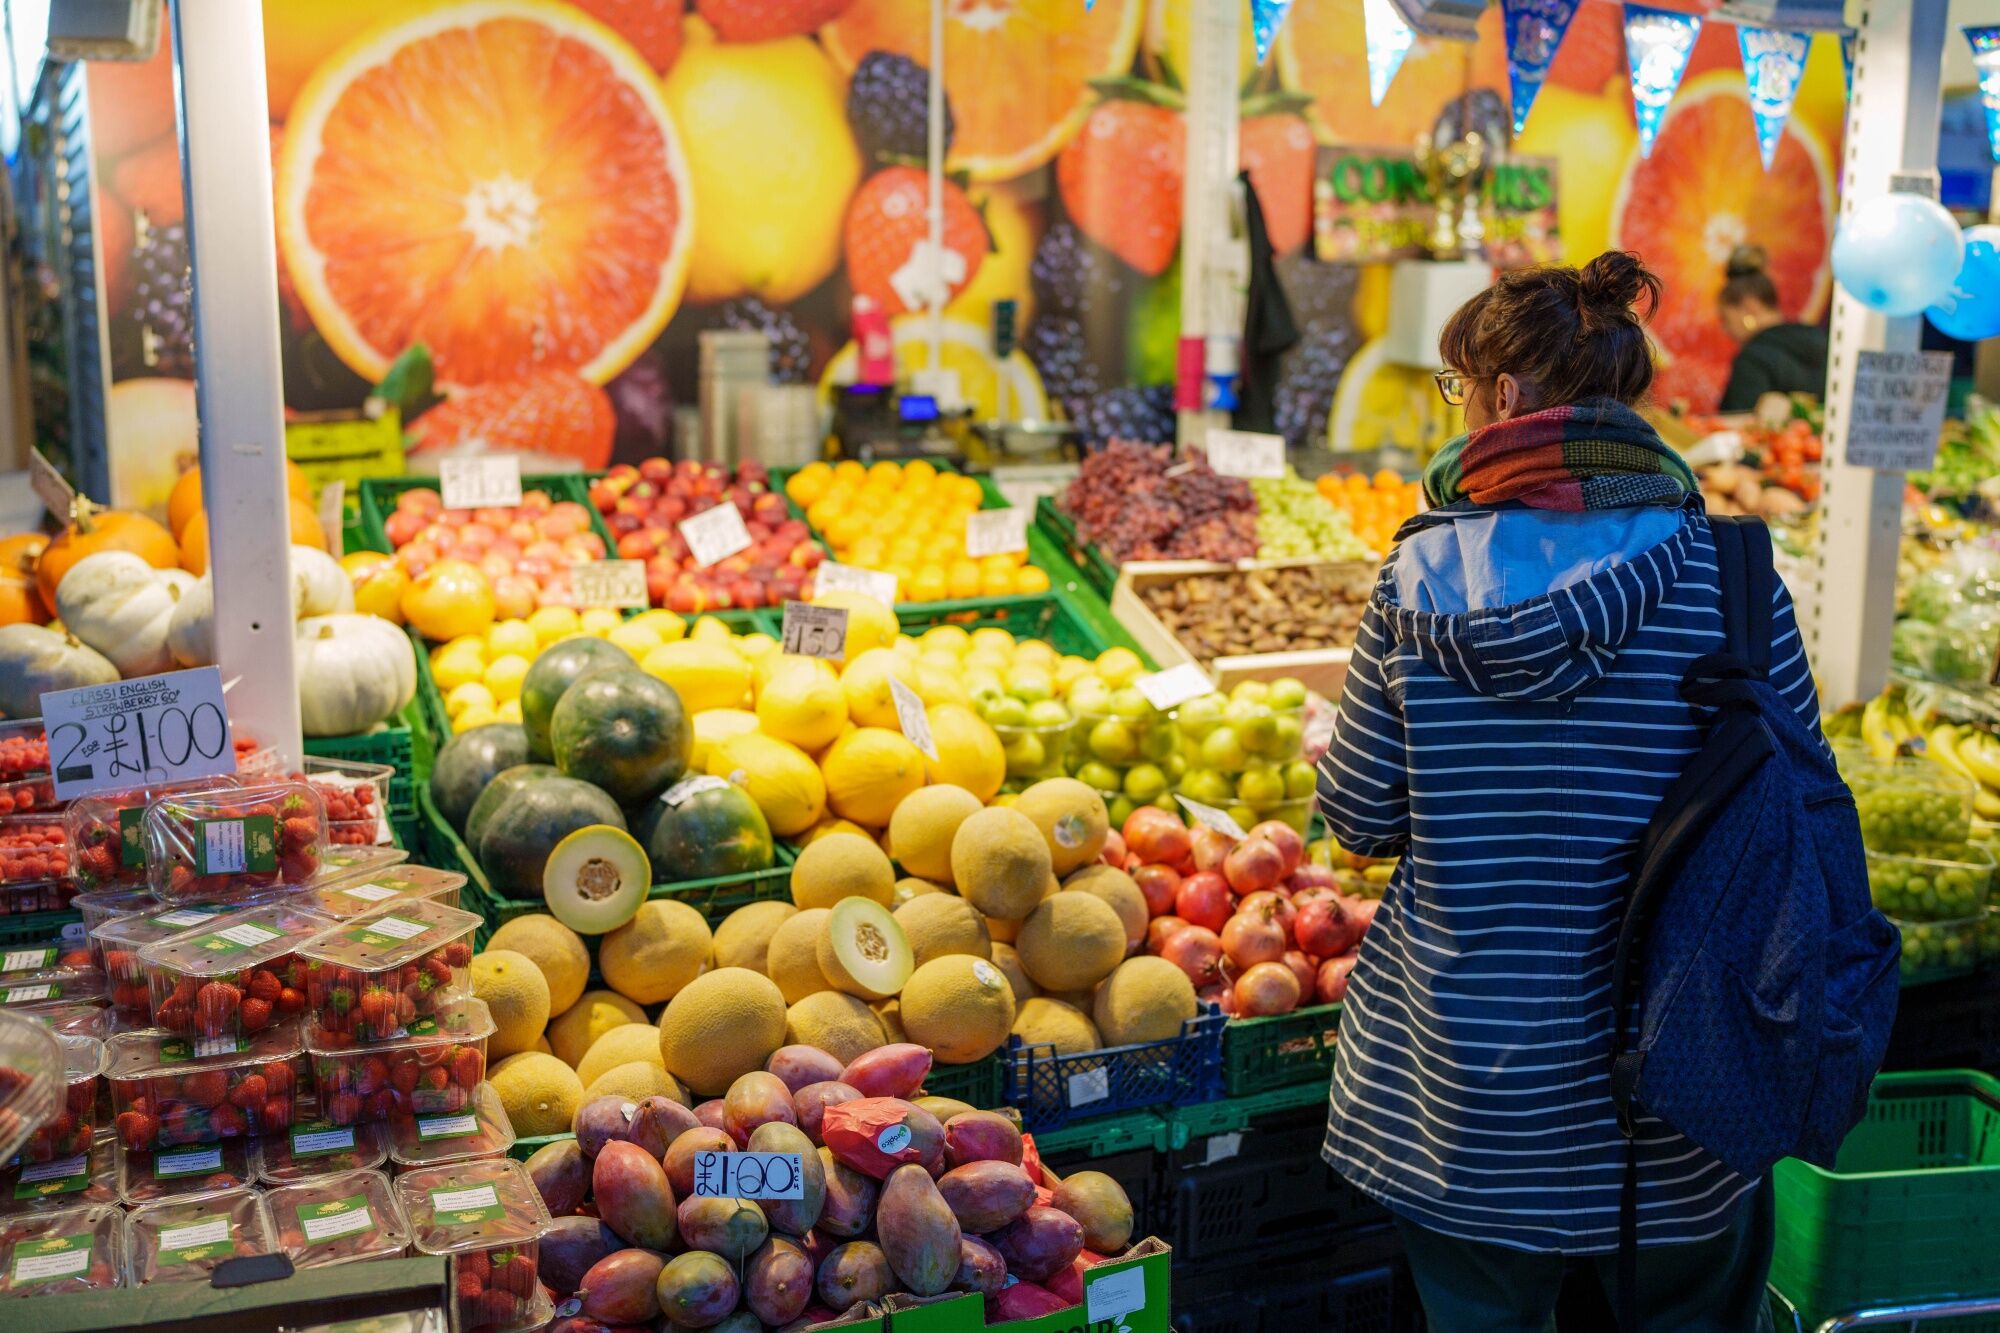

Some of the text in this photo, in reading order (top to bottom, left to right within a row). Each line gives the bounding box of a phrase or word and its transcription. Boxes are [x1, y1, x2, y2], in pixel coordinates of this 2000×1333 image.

[120, 680, 167, 697] ENGLISH
[85, 694, 158, 716] STRAWBERRY
[51, 722, 94, 784] 2
[81, 740, 100, 756] FOR
